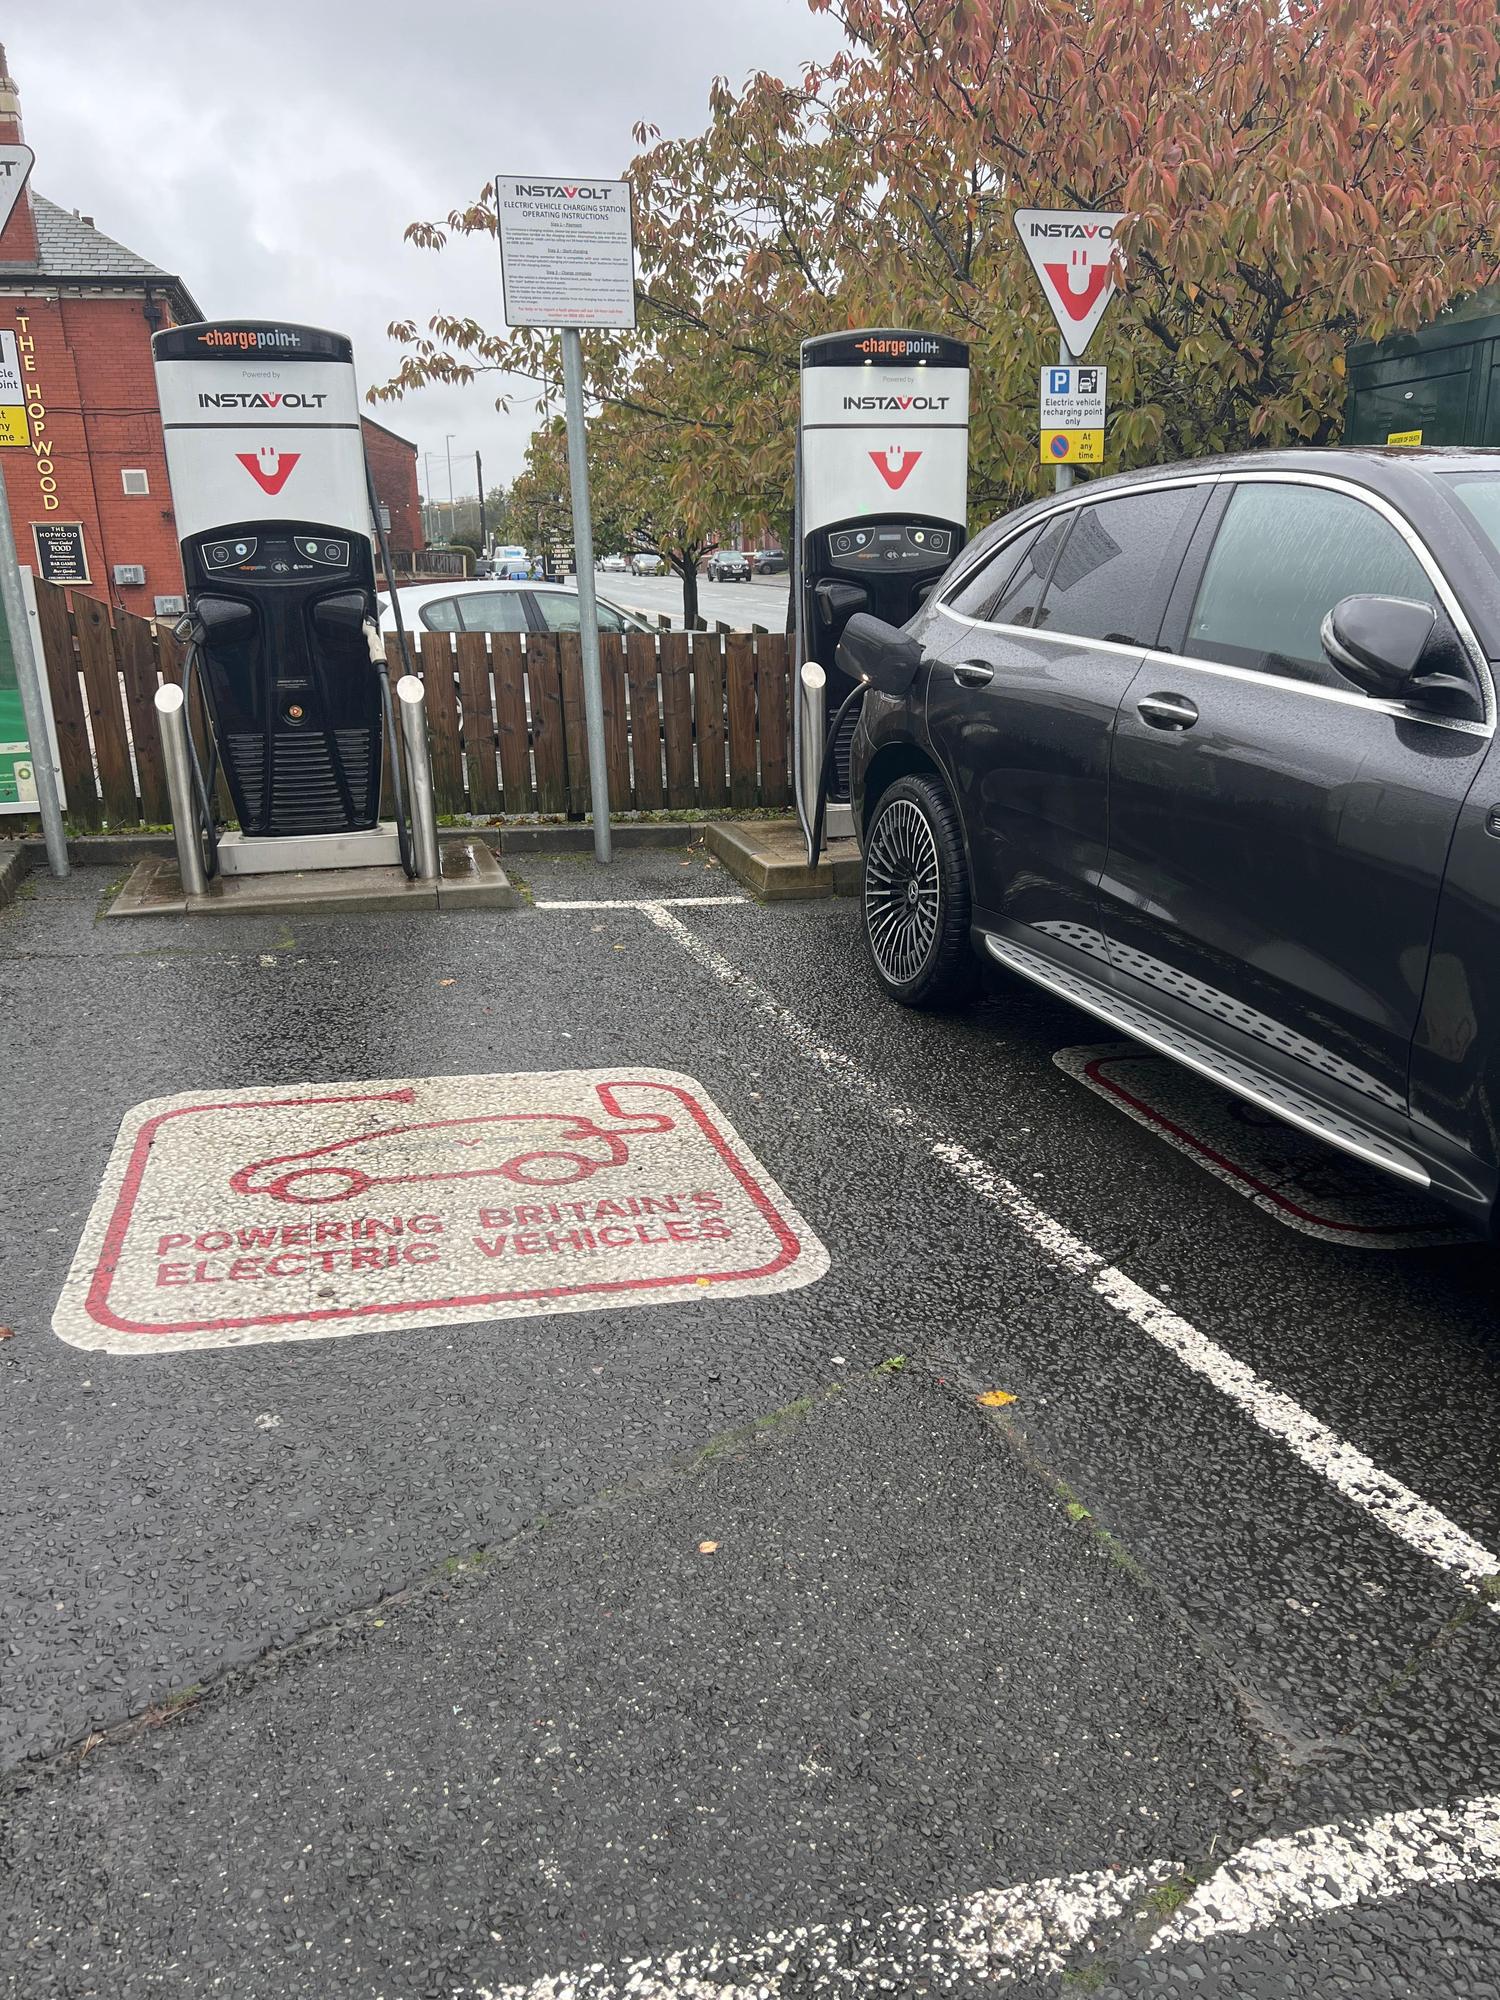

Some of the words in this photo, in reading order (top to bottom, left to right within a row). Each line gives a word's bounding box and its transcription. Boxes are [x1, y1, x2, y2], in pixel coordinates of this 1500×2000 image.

[516, 185, 612, 200] INSTAVOLT
[522, 210, 560, 219] OPERATING
[562, 212, 609, 220] INSTRUCTIONS
[563, 204, 598, 212] CHARGING
[1030, 222, 1113, 239] INSTAVO
[16, 316, 36, 371] THE
[272, 371, 280, 379] by
[907, 376, 914, 384] by
[1054, 372, 1067, 392] P
[0, 380, 18, 389] oint
[198, 392, 327, 408] INSTAVOLT
[844, 394, 950, 410] INSTAVOLT
[26, 384, 59, 510] HOPWOOD
[156, 1213, 444, 1257] POWERING
[477, 1191, 726, 1231] BRITAIN'S
[155, 1241, 442, 1287] ELECTRIC
[472, 1217, 735, 1259] VEHICLES
